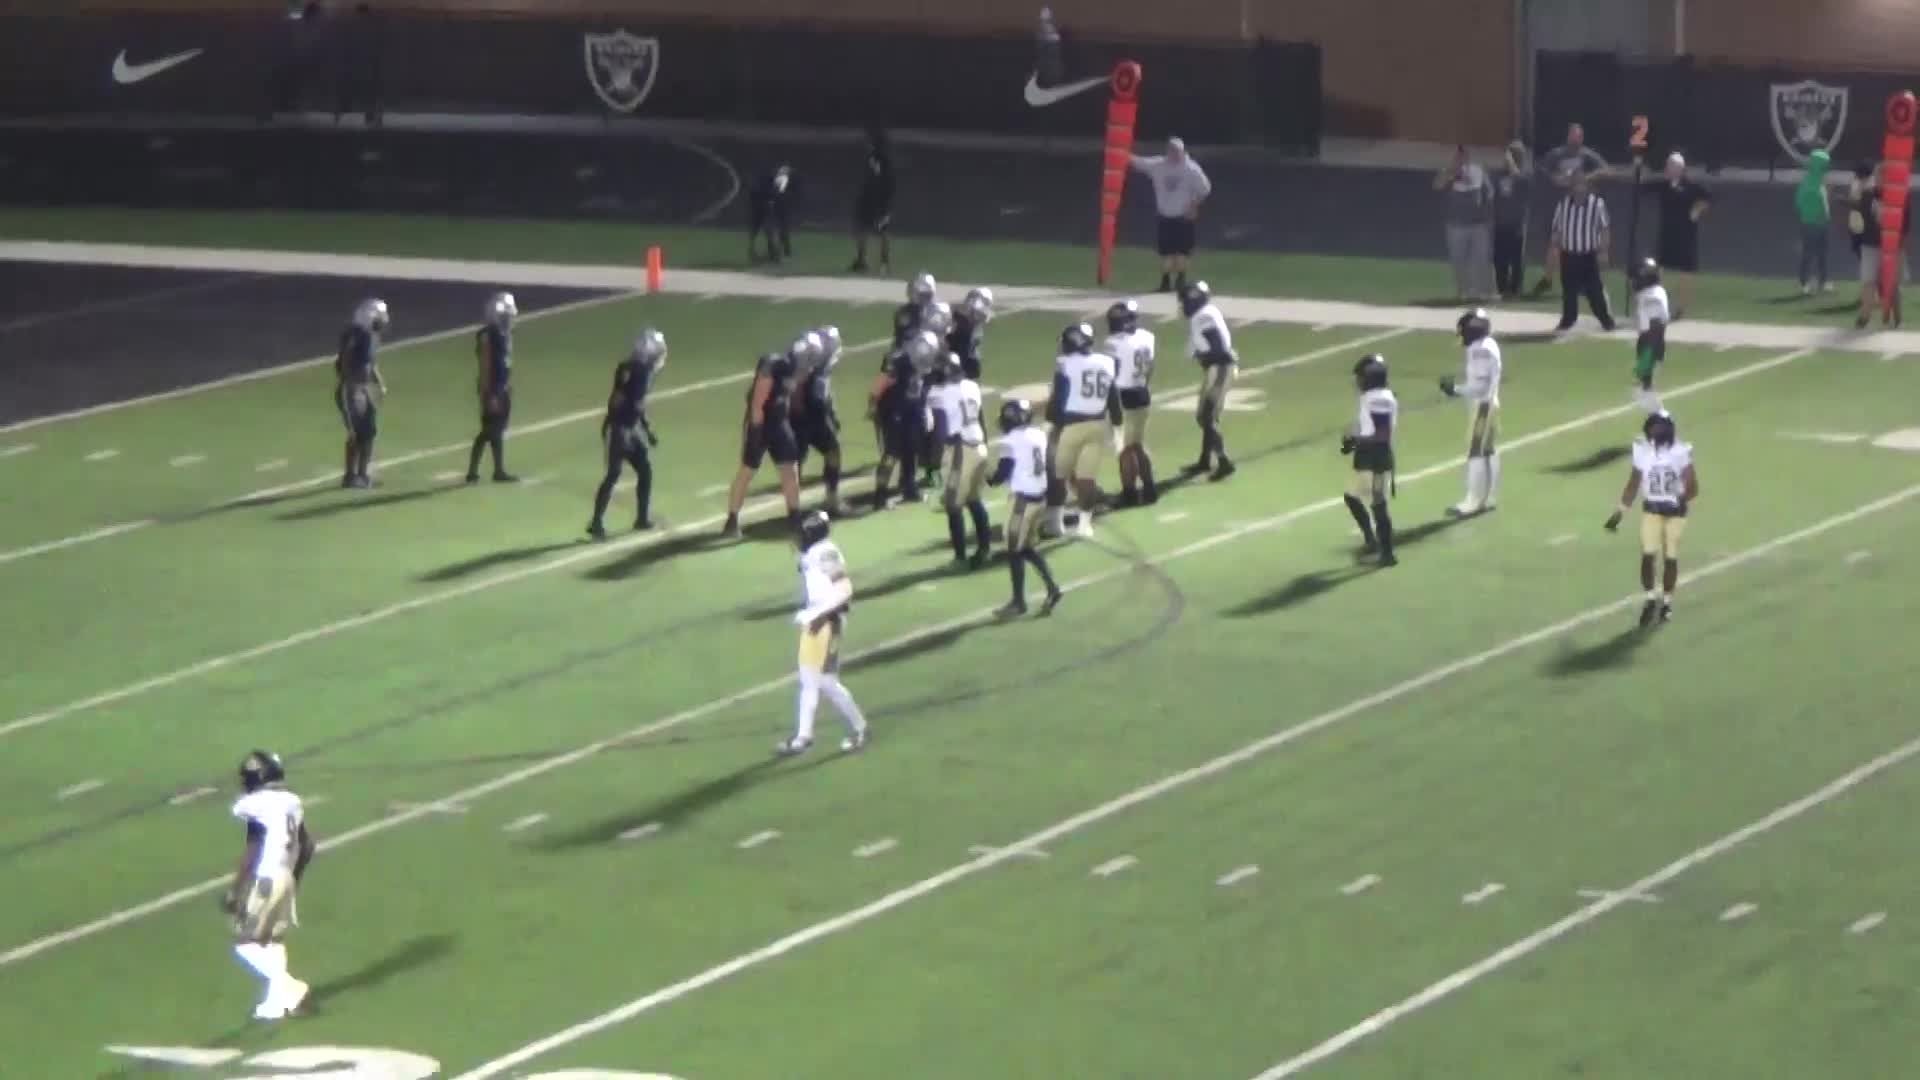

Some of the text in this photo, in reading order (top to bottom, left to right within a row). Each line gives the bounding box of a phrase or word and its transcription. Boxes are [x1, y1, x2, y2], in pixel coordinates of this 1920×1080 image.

[1630, 115, 1649, 147] 2
[1081, 369, 1108, 399] 56
[1648, 467, 1680, 496] 22
